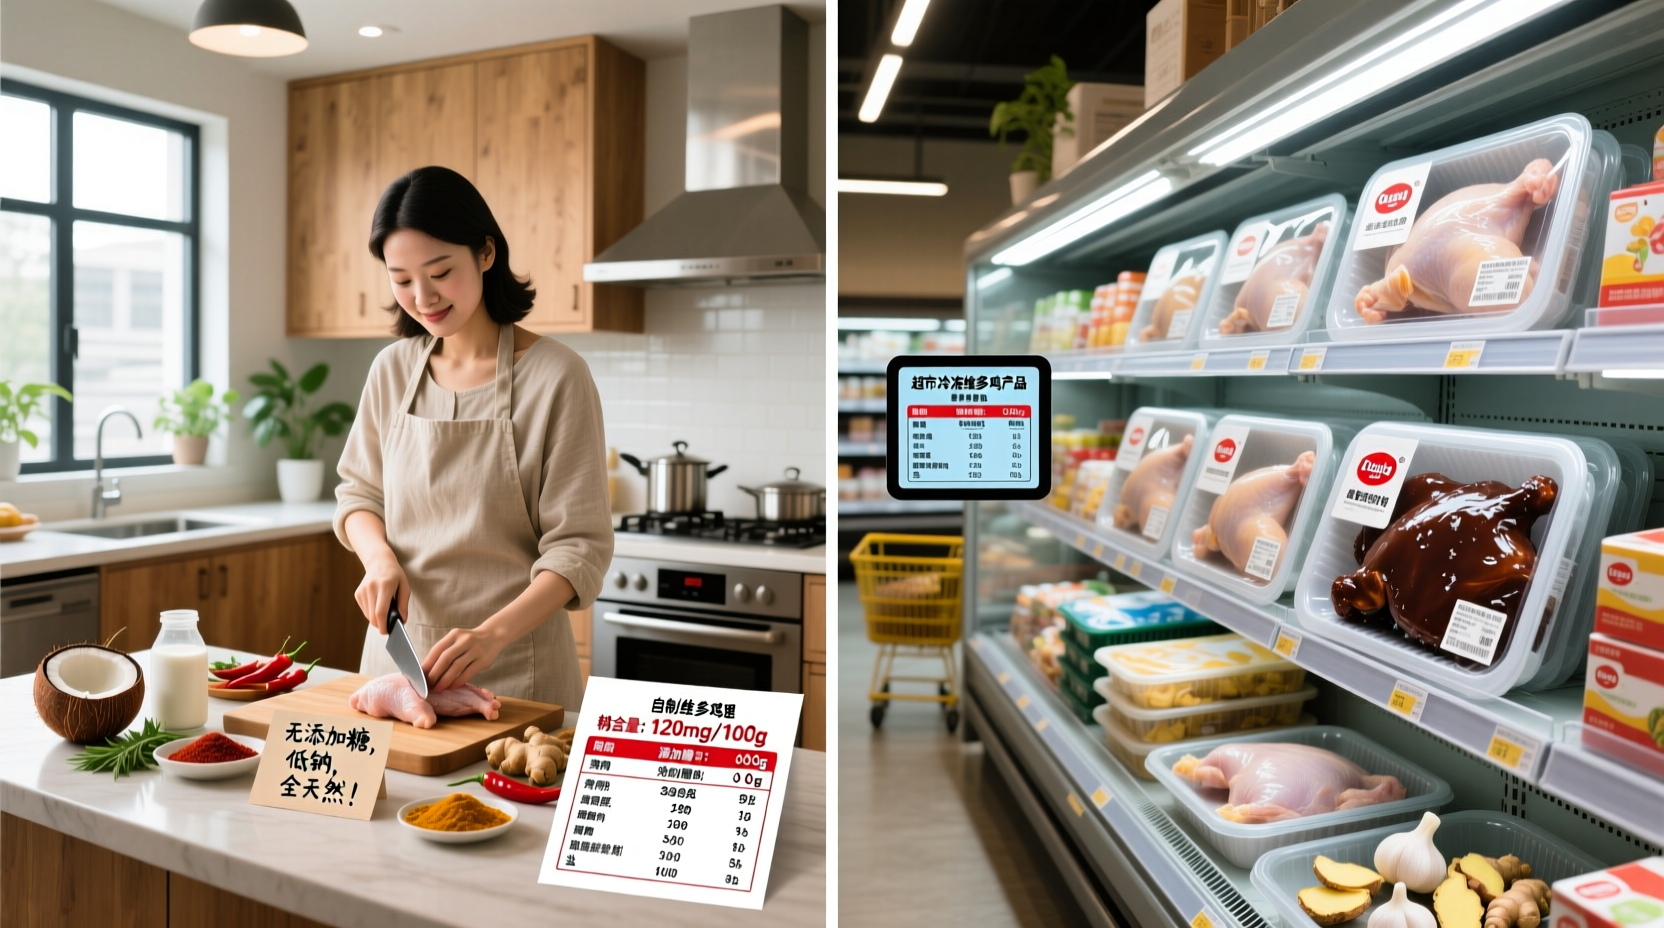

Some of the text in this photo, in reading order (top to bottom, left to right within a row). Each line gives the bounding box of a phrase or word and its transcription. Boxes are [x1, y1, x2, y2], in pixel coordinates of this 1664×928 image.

[286, 722, 375, 755] 无添加糖，
[651, 718, 768, 748] 120mg/100g
[286, 749, 338, 779] 低钠，
[280, 774, 359, 807] 全天然！
